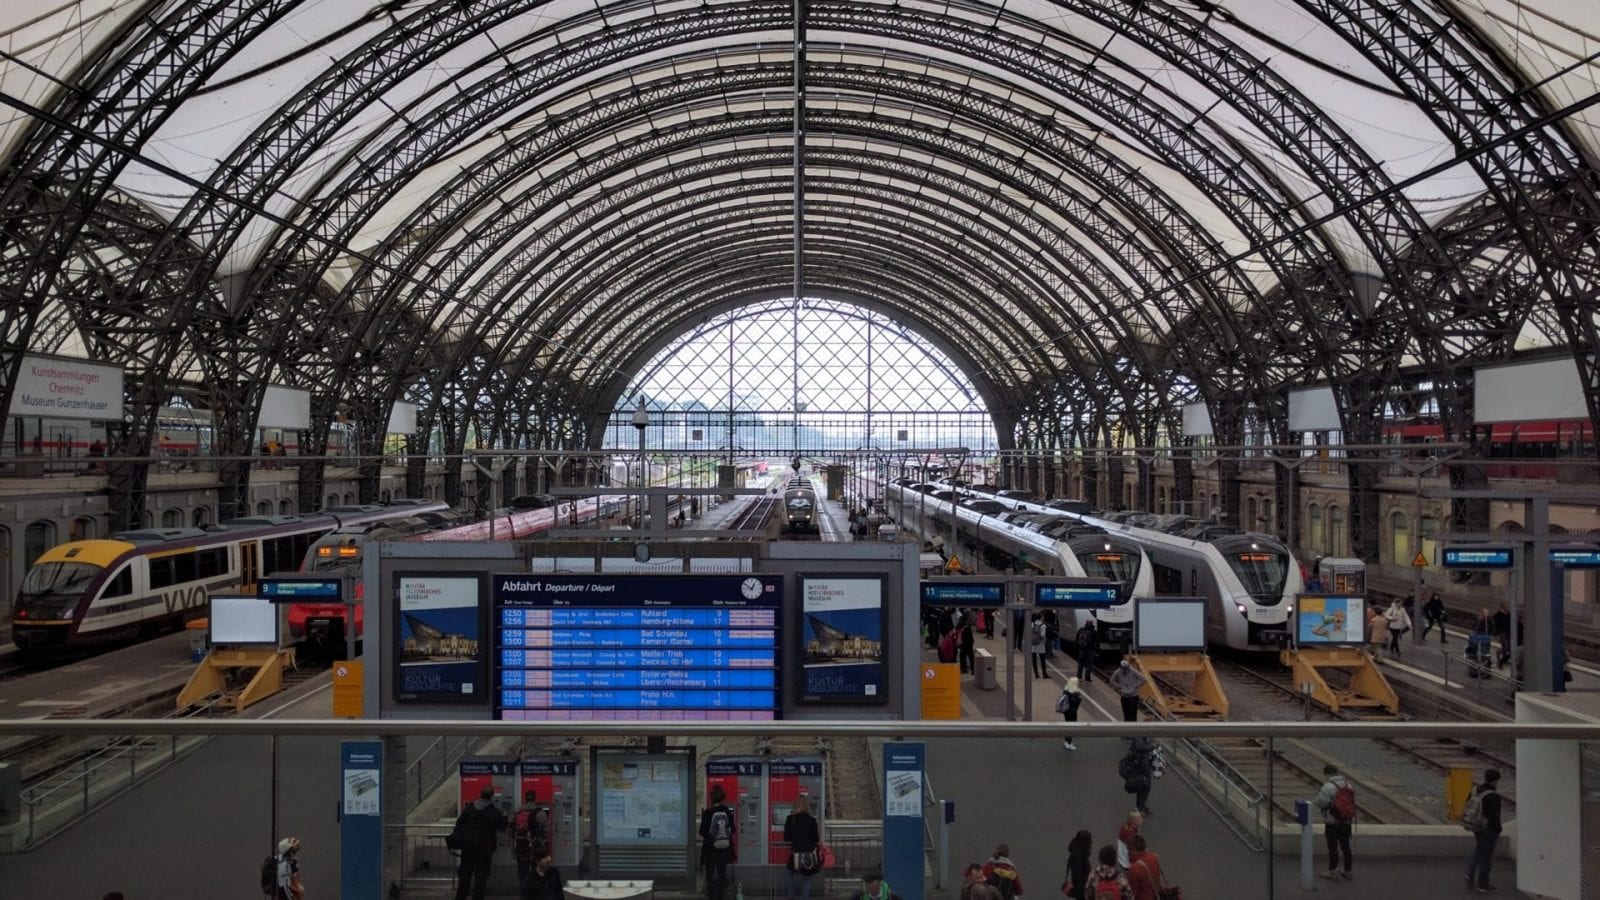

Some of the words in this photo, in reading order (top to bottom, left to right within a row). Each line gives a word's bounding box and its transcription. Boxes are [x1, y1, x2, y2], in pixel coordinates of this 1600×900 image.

[32, 366, 100, 384] Kunstsammlungen
[49, 382, 85, 395] Chemnitz
[22, 395, 56, 408] Museum
[57, 397, 108, 410] Gunzenhauser
[1447, 552, 1455, 561] 13
[262, 584, 268, 592] 9
[502, 581, 542, 592] Abfahrt
[545, 584, 584, 592] Departure
[591, 583, 615, 592] Départ
[926, 587, 935, 596] 11
[1106, 589, 1116, 598] 12
[162, 585, 208, 614] VVO
[641, 618, 694, 626] Hamburg-Altona
